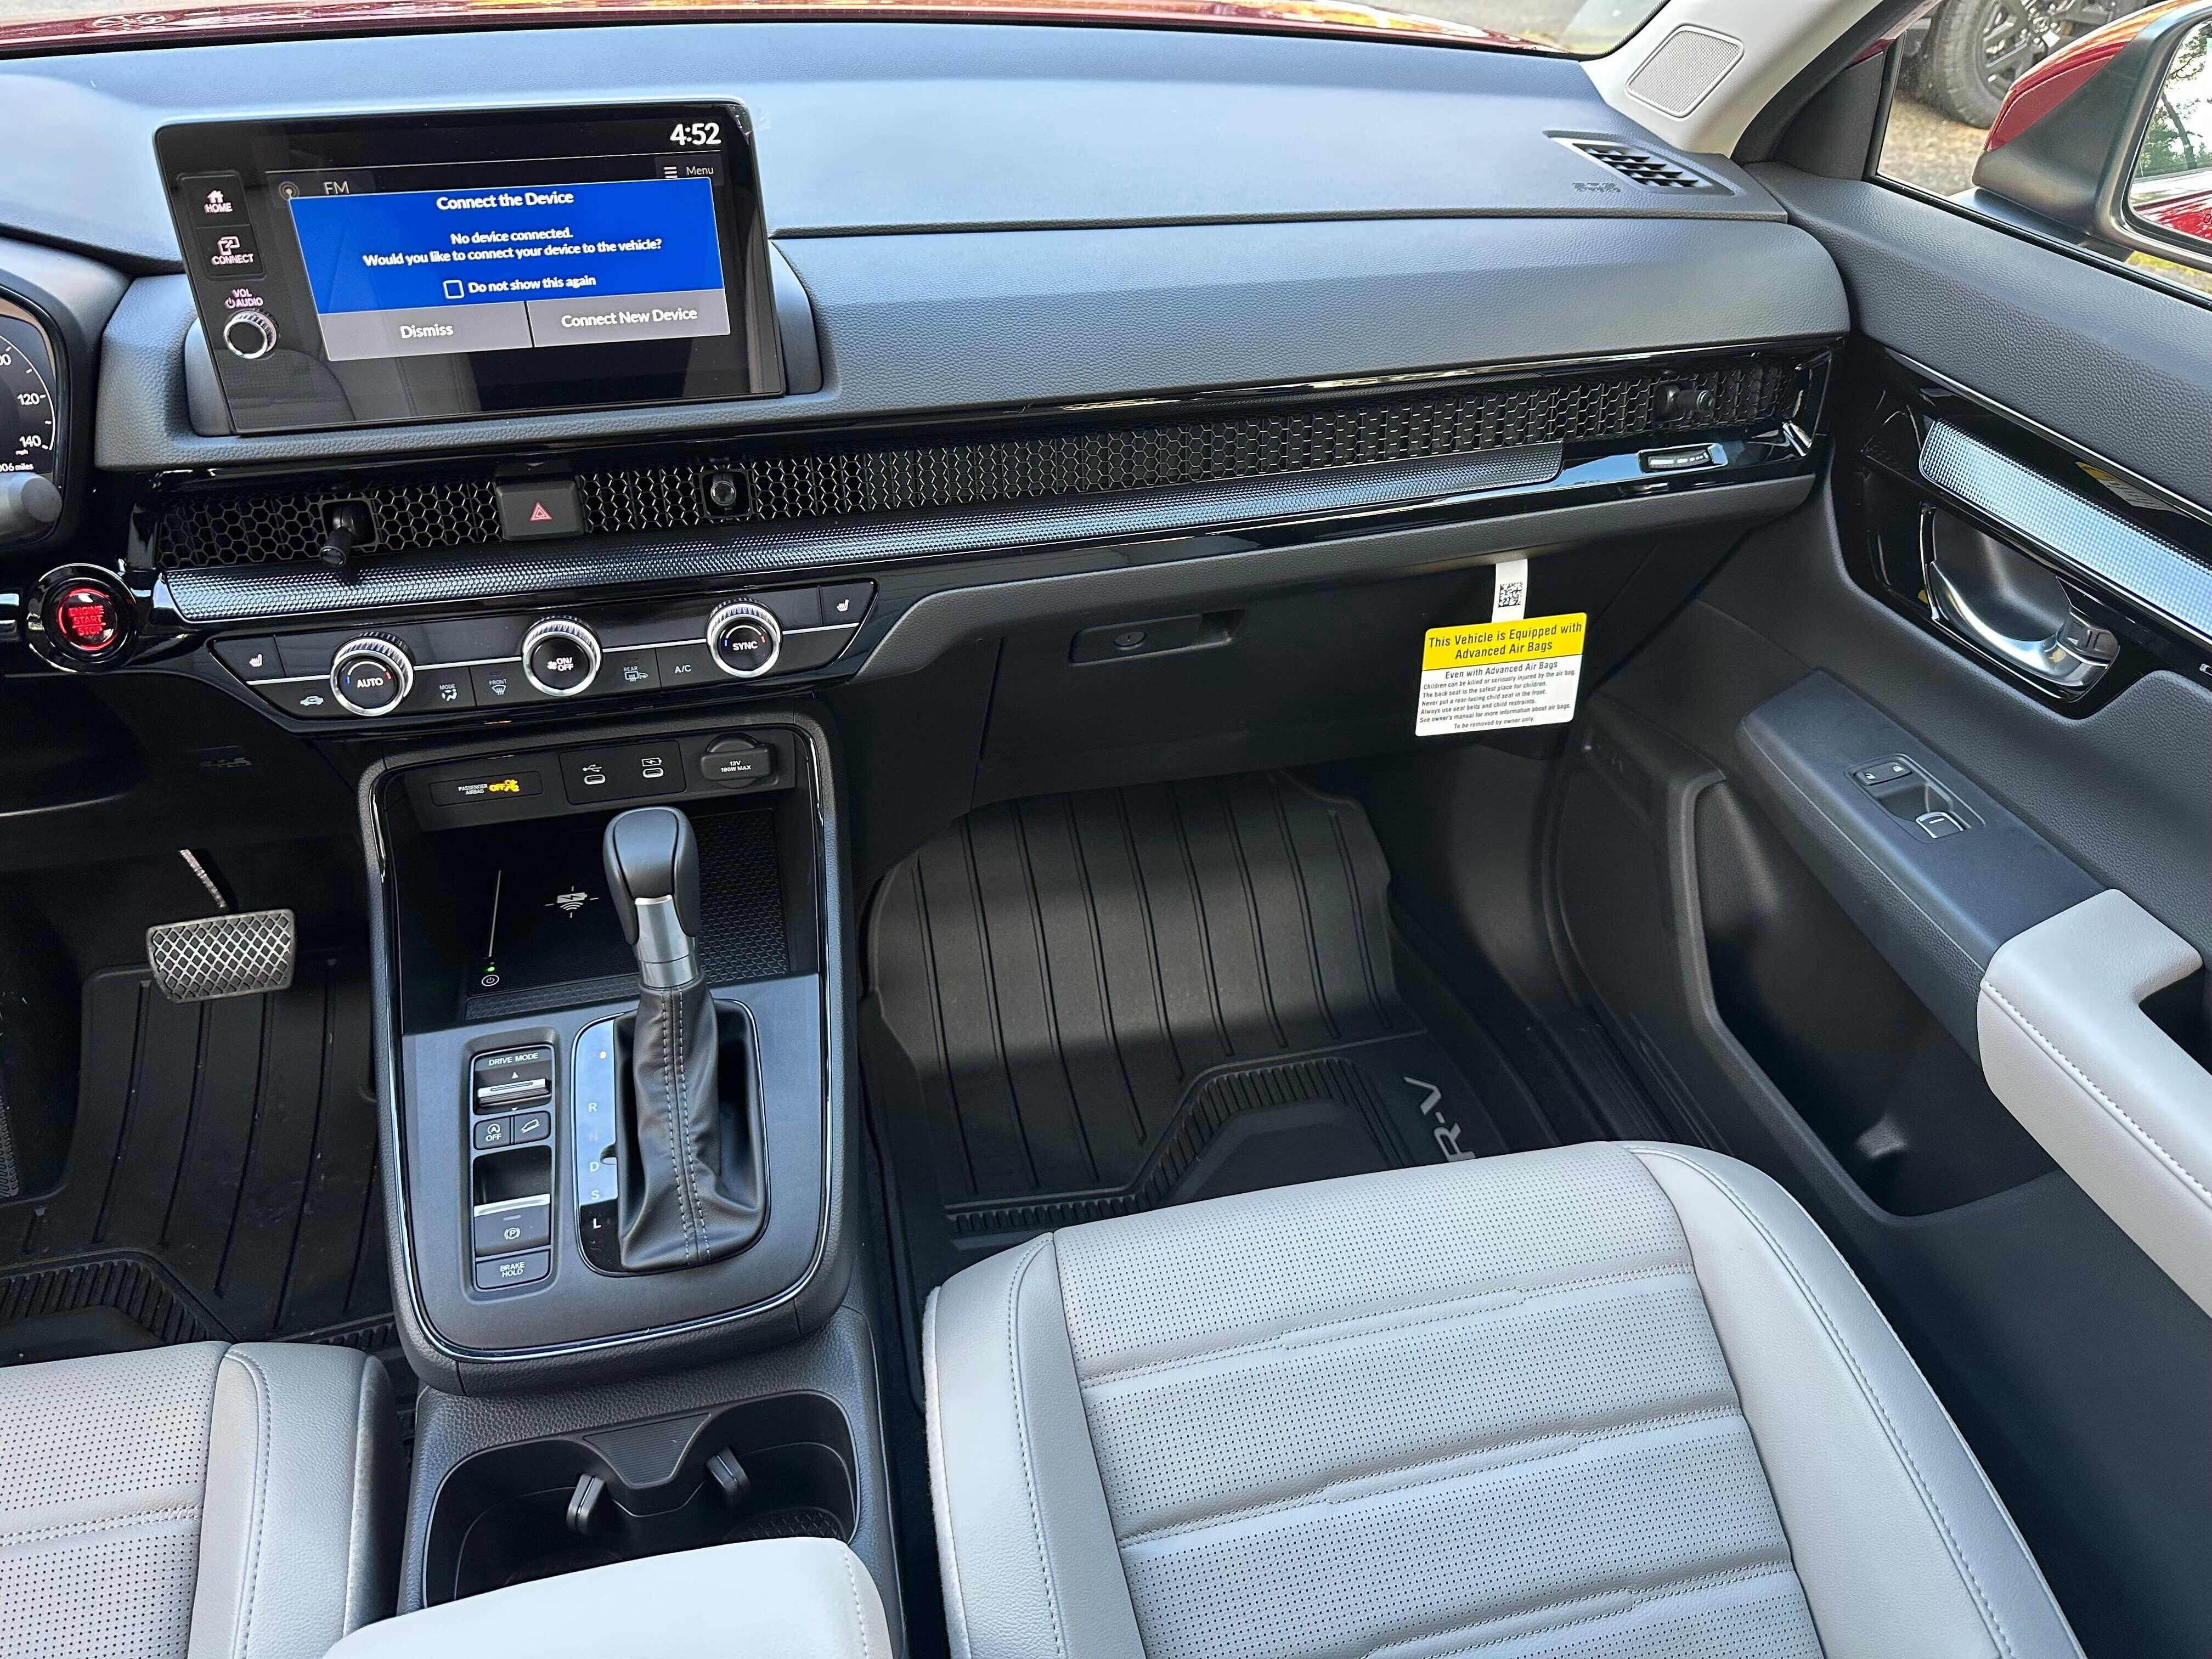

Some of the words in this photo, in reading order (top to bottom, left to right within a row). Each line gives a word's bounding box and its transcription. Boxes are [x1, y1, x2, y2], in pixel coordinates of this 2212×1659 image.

[670, 122, 721, 145] 4:52
[686, 166, 714, 176] Menu
[324, 180, 349, 195] FM
[436, 195, 497, 210] Connect
[498, 193, 523, 207] the
[524, 191, 574, 206] Device
[204, 202, 233, 213] HOME
[450, 233, 470, 245] No
[471, 231, 509, 243] device
[510, 227, 574, 241] connected.
[362, 252, 404, 267] Would
[405, 253, 428, 266] you
[430, 251, 451, 262] like
[452, 251, 466, 261] to
[467, 247, 515, 260] connect
[515, 246, 542, 259] your
[544, 244, 581, 256] device
[582, 243, 595, 253] to
[597, 241, 617, 252] the
[618, 238, 662, 251] vehicle?
[211, 253, 254, 266] CONNECT
[467, 281, 487, 294] Do
[488, 280, 509, 292] not
[510, 279, 540, 291] show
[542, 276, 564, 289] this
[566, 275, 596, 289] again
[232, 288, 252, 298] VOL
[236, 297, 263, 308] AUDIO
[561, 313, 618, 328] Connect
[619, 311, 650, 324] New
[652, 307, 698, 321] Device
[400, 323, 454, 338] Dismiss
[18, 392, 40, 405] 120
[19, 435, 42, 448] 140
[69, 605, 104, 617] ENGINE
[74, 615, 103, 624] START
[78, 626, 103, 636] STOP
[1429, 636, 1451, 647] This
[1455, 632, 1493, 645] Vehicle
[1497, 631, 1505, 641] is
[1509, 624, 1557, 641] Equipped
[1560, 622, 1582, 634] with
[732, 641, 758, 651] SYNC
[1455, 644, 1505, 659] Advanced
[1509, 643, 1525, 654] Air
[1527, 642, 1553, 653] Bags
[556, 657, 572, 665] ON/
[675, 664, 691, 674] A/C
[1445, 671, 1464, 679] Even
[1466, 668, 1483, 676] with
[1485, 664, 1523, 675] Advanced
[1539, 662, 1558, 670] Bags
[357, 677, 383, 689] AUTO
[458, 783, 488, 792] PASSENGER
[489, 783, 505, 792] OFF
[489, 1056, 512, 1066] DRIVE
[515, 1052, 539, 1063] MODE
[588, 1102, 597, 1113] R
[486, 1133, 502, 1142] OFF
[588, 1132, 599, 1142] N
[589, 1161, 600, 1172] D
[591, 1189, 600, 1200] S
[592, 1218, 602, 1229] L
[500, 1261, 525, 1272] BRAKE
[501, 1268, 523, 1278] HOLD
